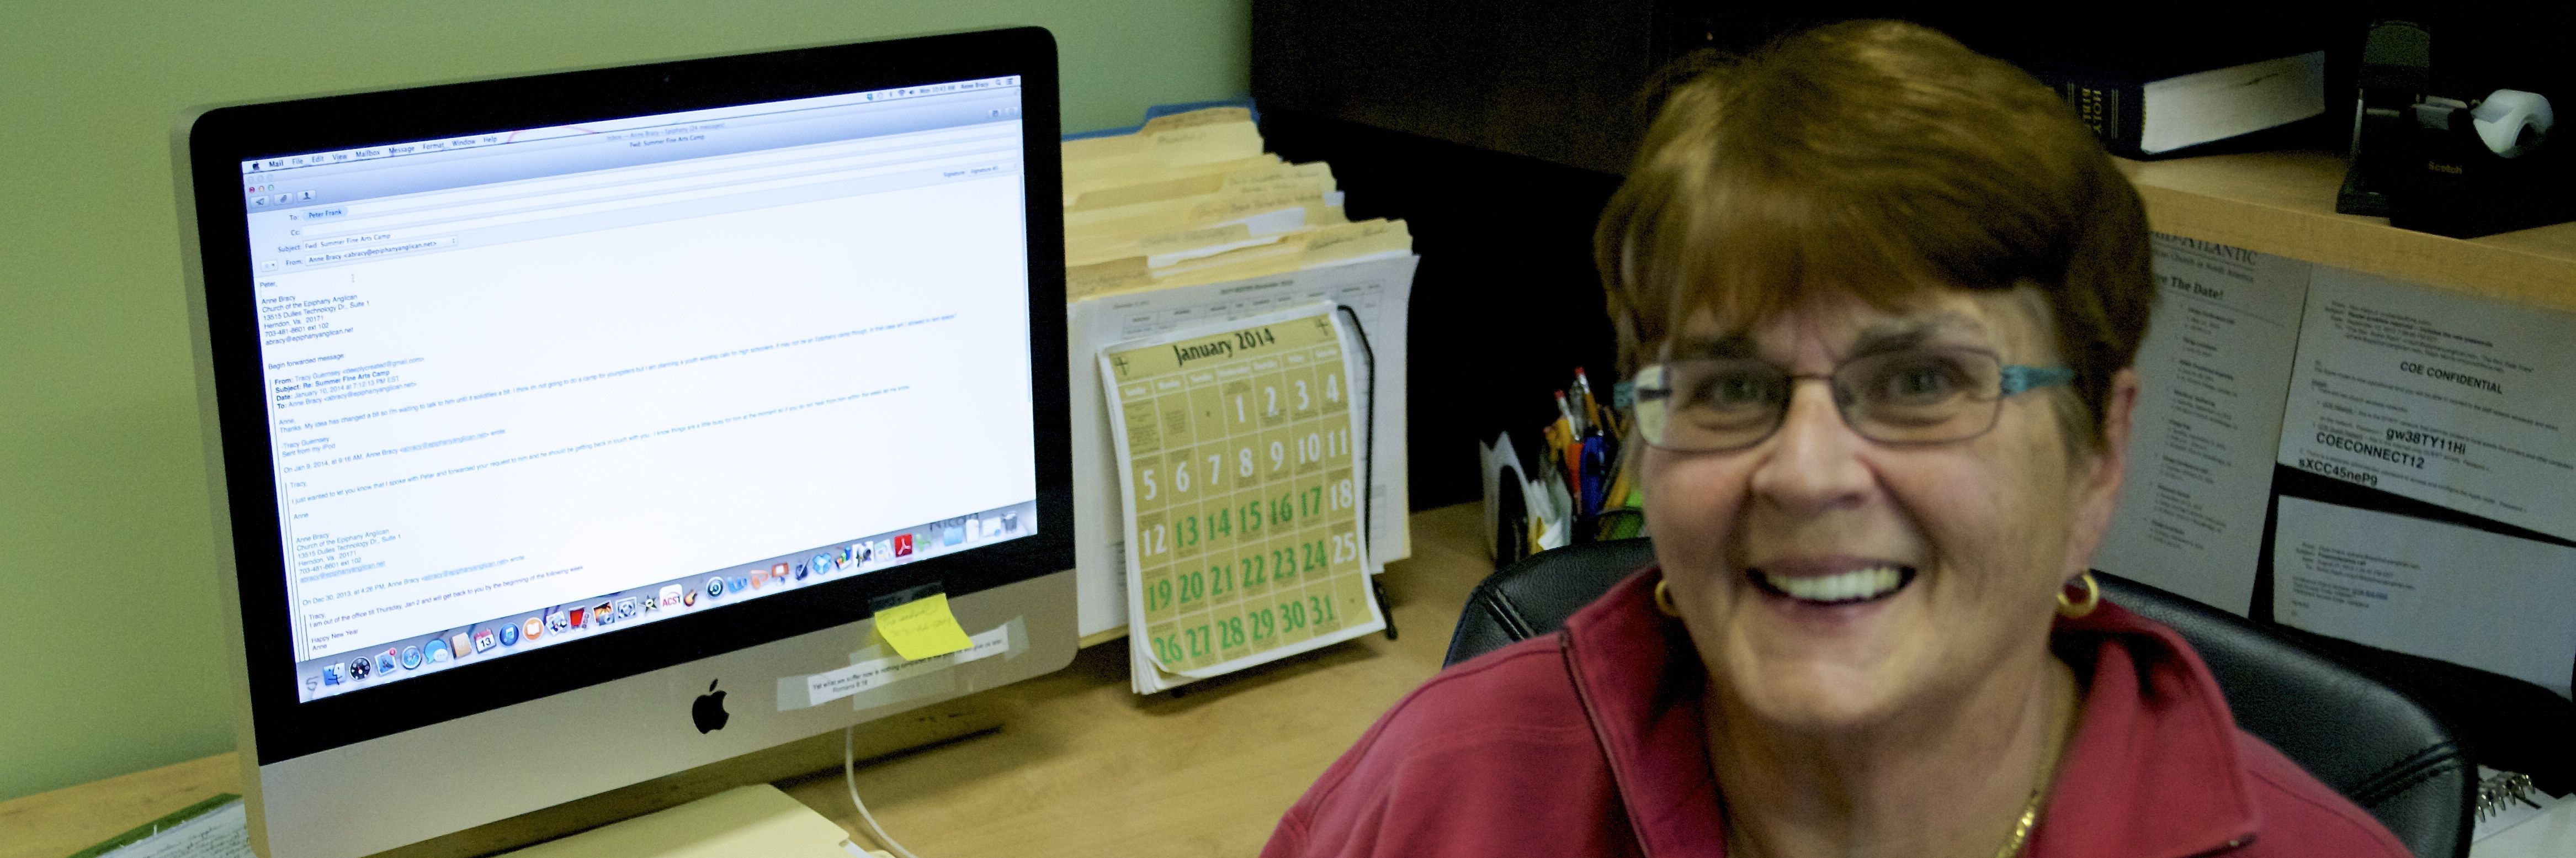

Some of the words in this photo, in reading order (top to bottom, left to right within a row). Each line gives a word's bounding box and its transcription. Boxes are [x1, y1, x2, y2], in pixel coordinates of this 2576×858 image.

[2092, 90, 2102, 135] HOLY
[268, 159, 284, 167] Mail
[332, 153, 347, 162] View
[389, 146, 415, 156] Message
[422, 142, 445, 150] Format
[262, 304, 284, 313] Church
[303, 299, 331, 307] Epiphany
[332, 294, 358, 303] Anglican
[2171, 276, 2191, 290] The
[2193, 282, 2224, 299] Date!
[263, 313, 282, 321] 13515
[302, 306, 336, 315] Technology
[286, 357, 316, 367] forwarded
[1175, 336, 1234, 368] January
[1239, 328, 1276, 352] 2014
[315, 378, 341, 387] Summer
[2400, 361, 2424, 375] COE
[2426, 367, 2503, 394] CONFIDENTIAL
[1236, 395, 1245, 423] 1
[1265, 386, 1278, 416] 2
[1295, 380, 1309, 410] 3
[1326, 374, 1339, 402] 4
[1143, 469, 1157, 500] 5
[1176, 462, 1189, 492] 6
[1208, 454, 1220, 485] 7
[1239, 447, 1254, 476] 8
[1270, 441, 1284, 470] 9
[1298, 432, 1321, 463] 10
[1327, 428, 1347, 457] 11
[2316, 431, 2425, 469] COECONNECT12
[1143, 525, 1167, 557] 12
[1176, 516, 1199, 548] 13
[1208, 509, 1231, 540] 14
[1240, 500, 1262, 533] 15
[1271, 494, 1293, 524] 16
[1301, 486, 1321, 517] 17
[1331, 479, 1353, 510] 18
[1149, 579, 1172, 611] 19
[1179, 571, 1204, 603] 20
[1211, 565, 1233, 596] 21
[1242, 555, 1265, 587] 22
[1273, 548, 1296, 580] 23
[1303, 541, 1327, 572] 24
[1332, 532, 1357, 564] 25
[481, 637, 491, 648] 13
[1154, 634, 1183, 664] 26
[1186, 625, 1210, 658] 27
[1218, 617, 1245, 649] 28
[1250, 608, 1274, 640] 29
[1280, 601, 1305, 633] 30
[1309, 596, 1334, 625] 31
